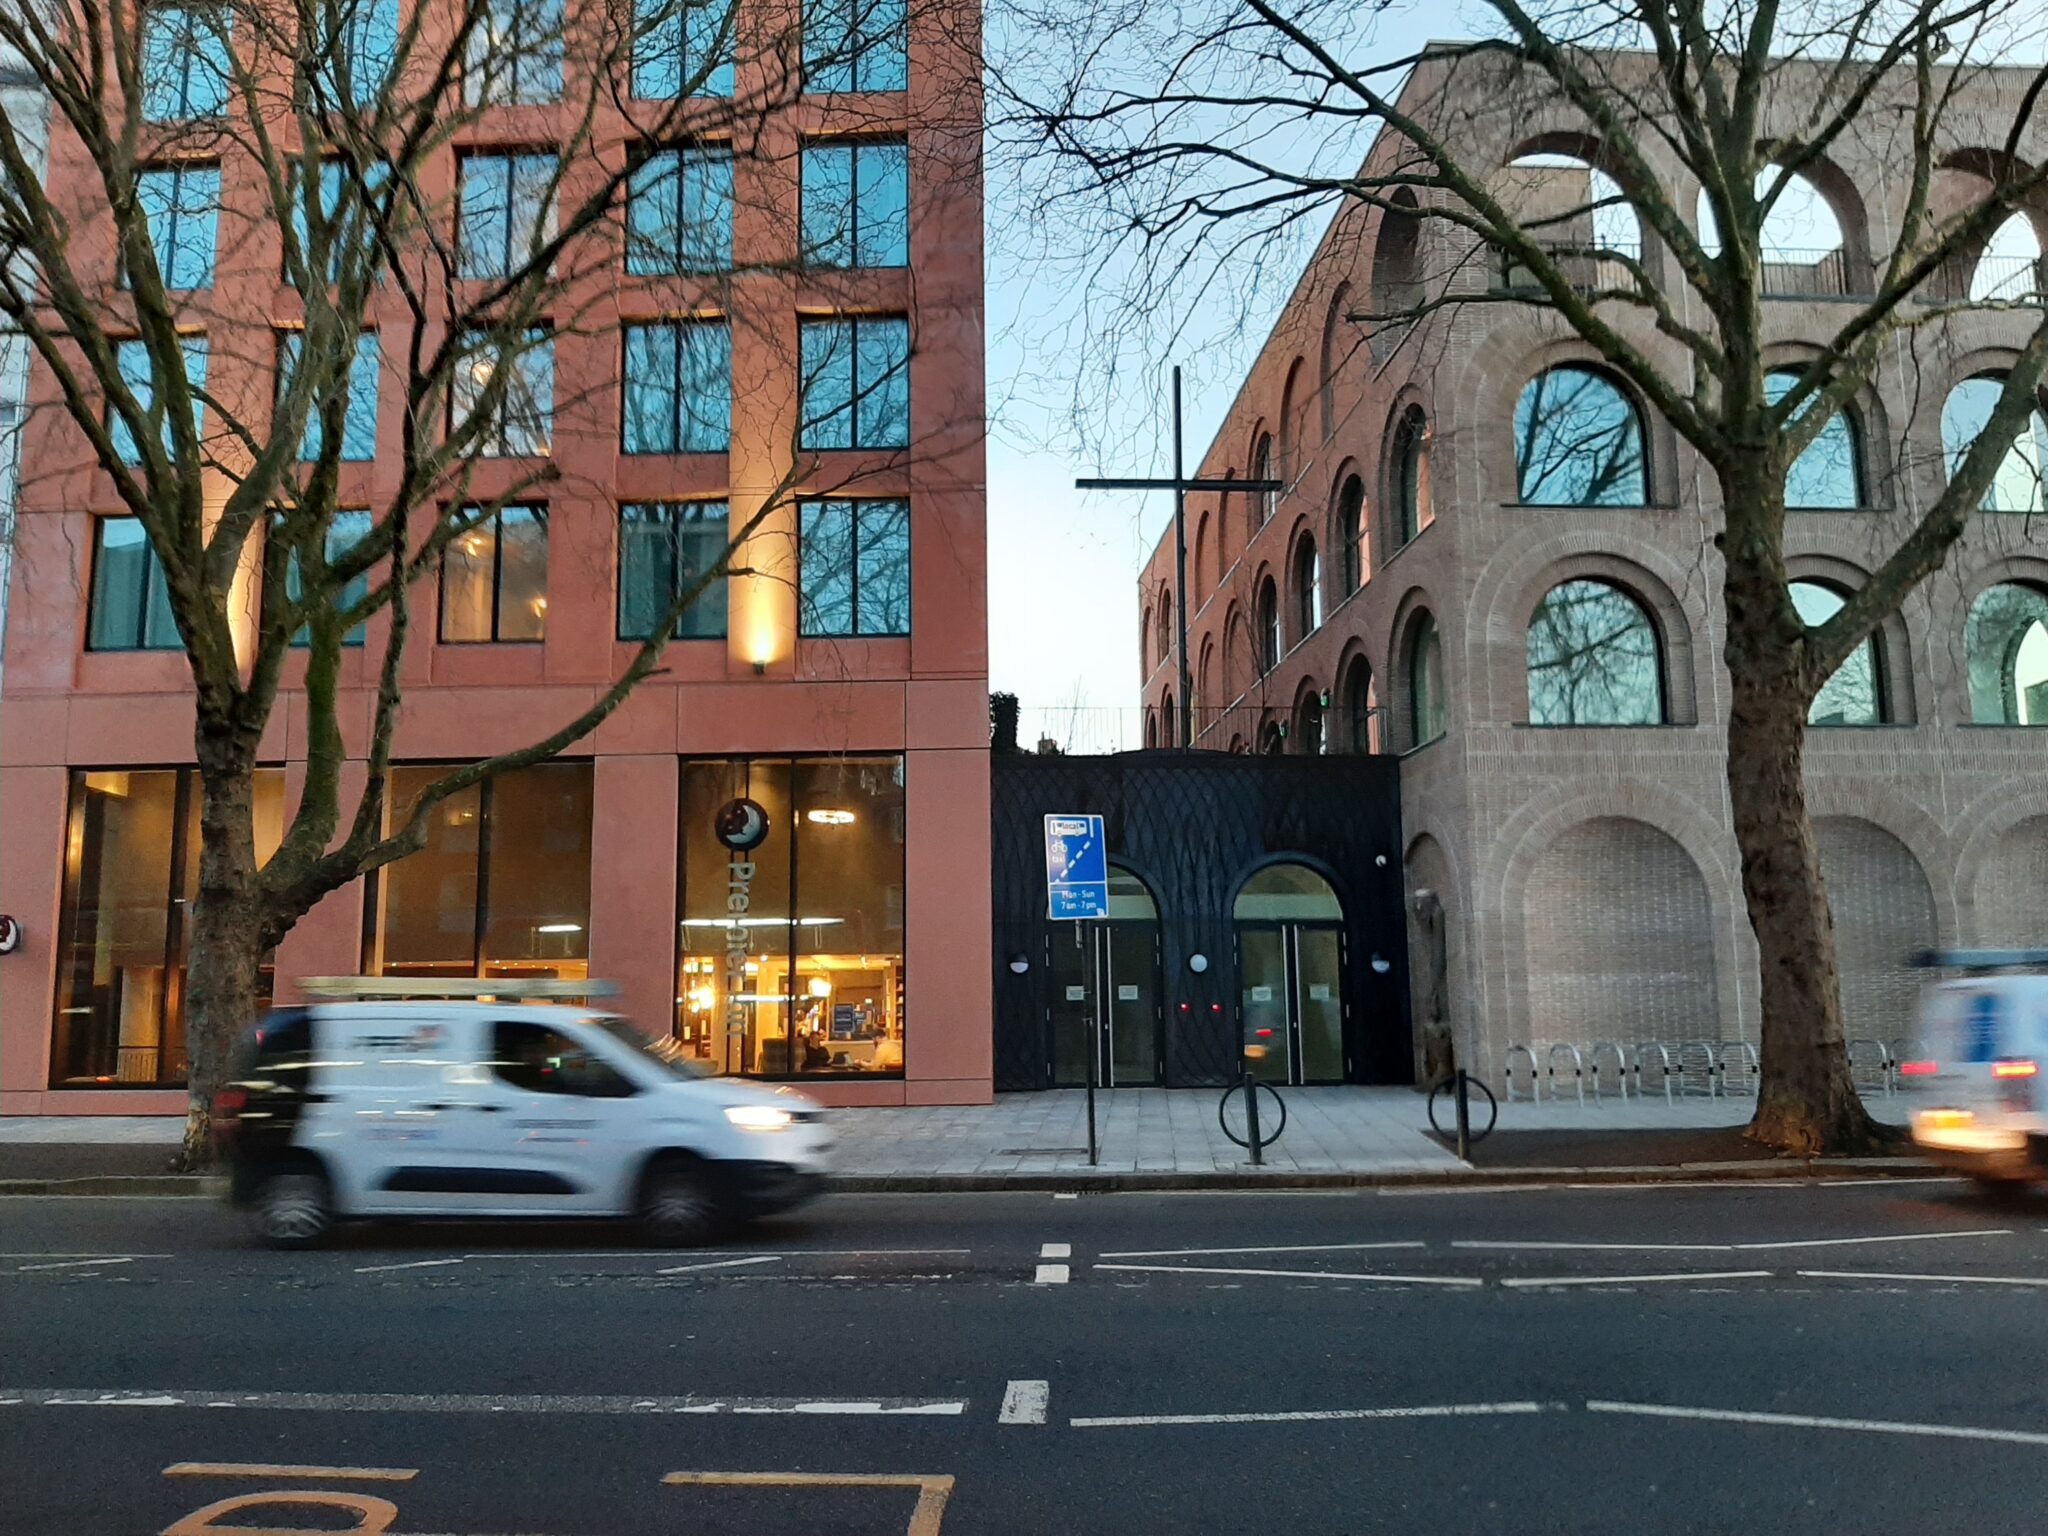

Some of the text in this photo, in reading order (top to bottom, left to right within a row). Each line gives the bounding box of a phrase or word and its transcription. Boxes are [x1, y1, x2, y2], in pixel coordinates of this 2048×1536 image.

[1062, 822, 1079, 830] local
[1061, 890, 1077, 899] Mon
[1081, 890, 1096, 898] Sun
